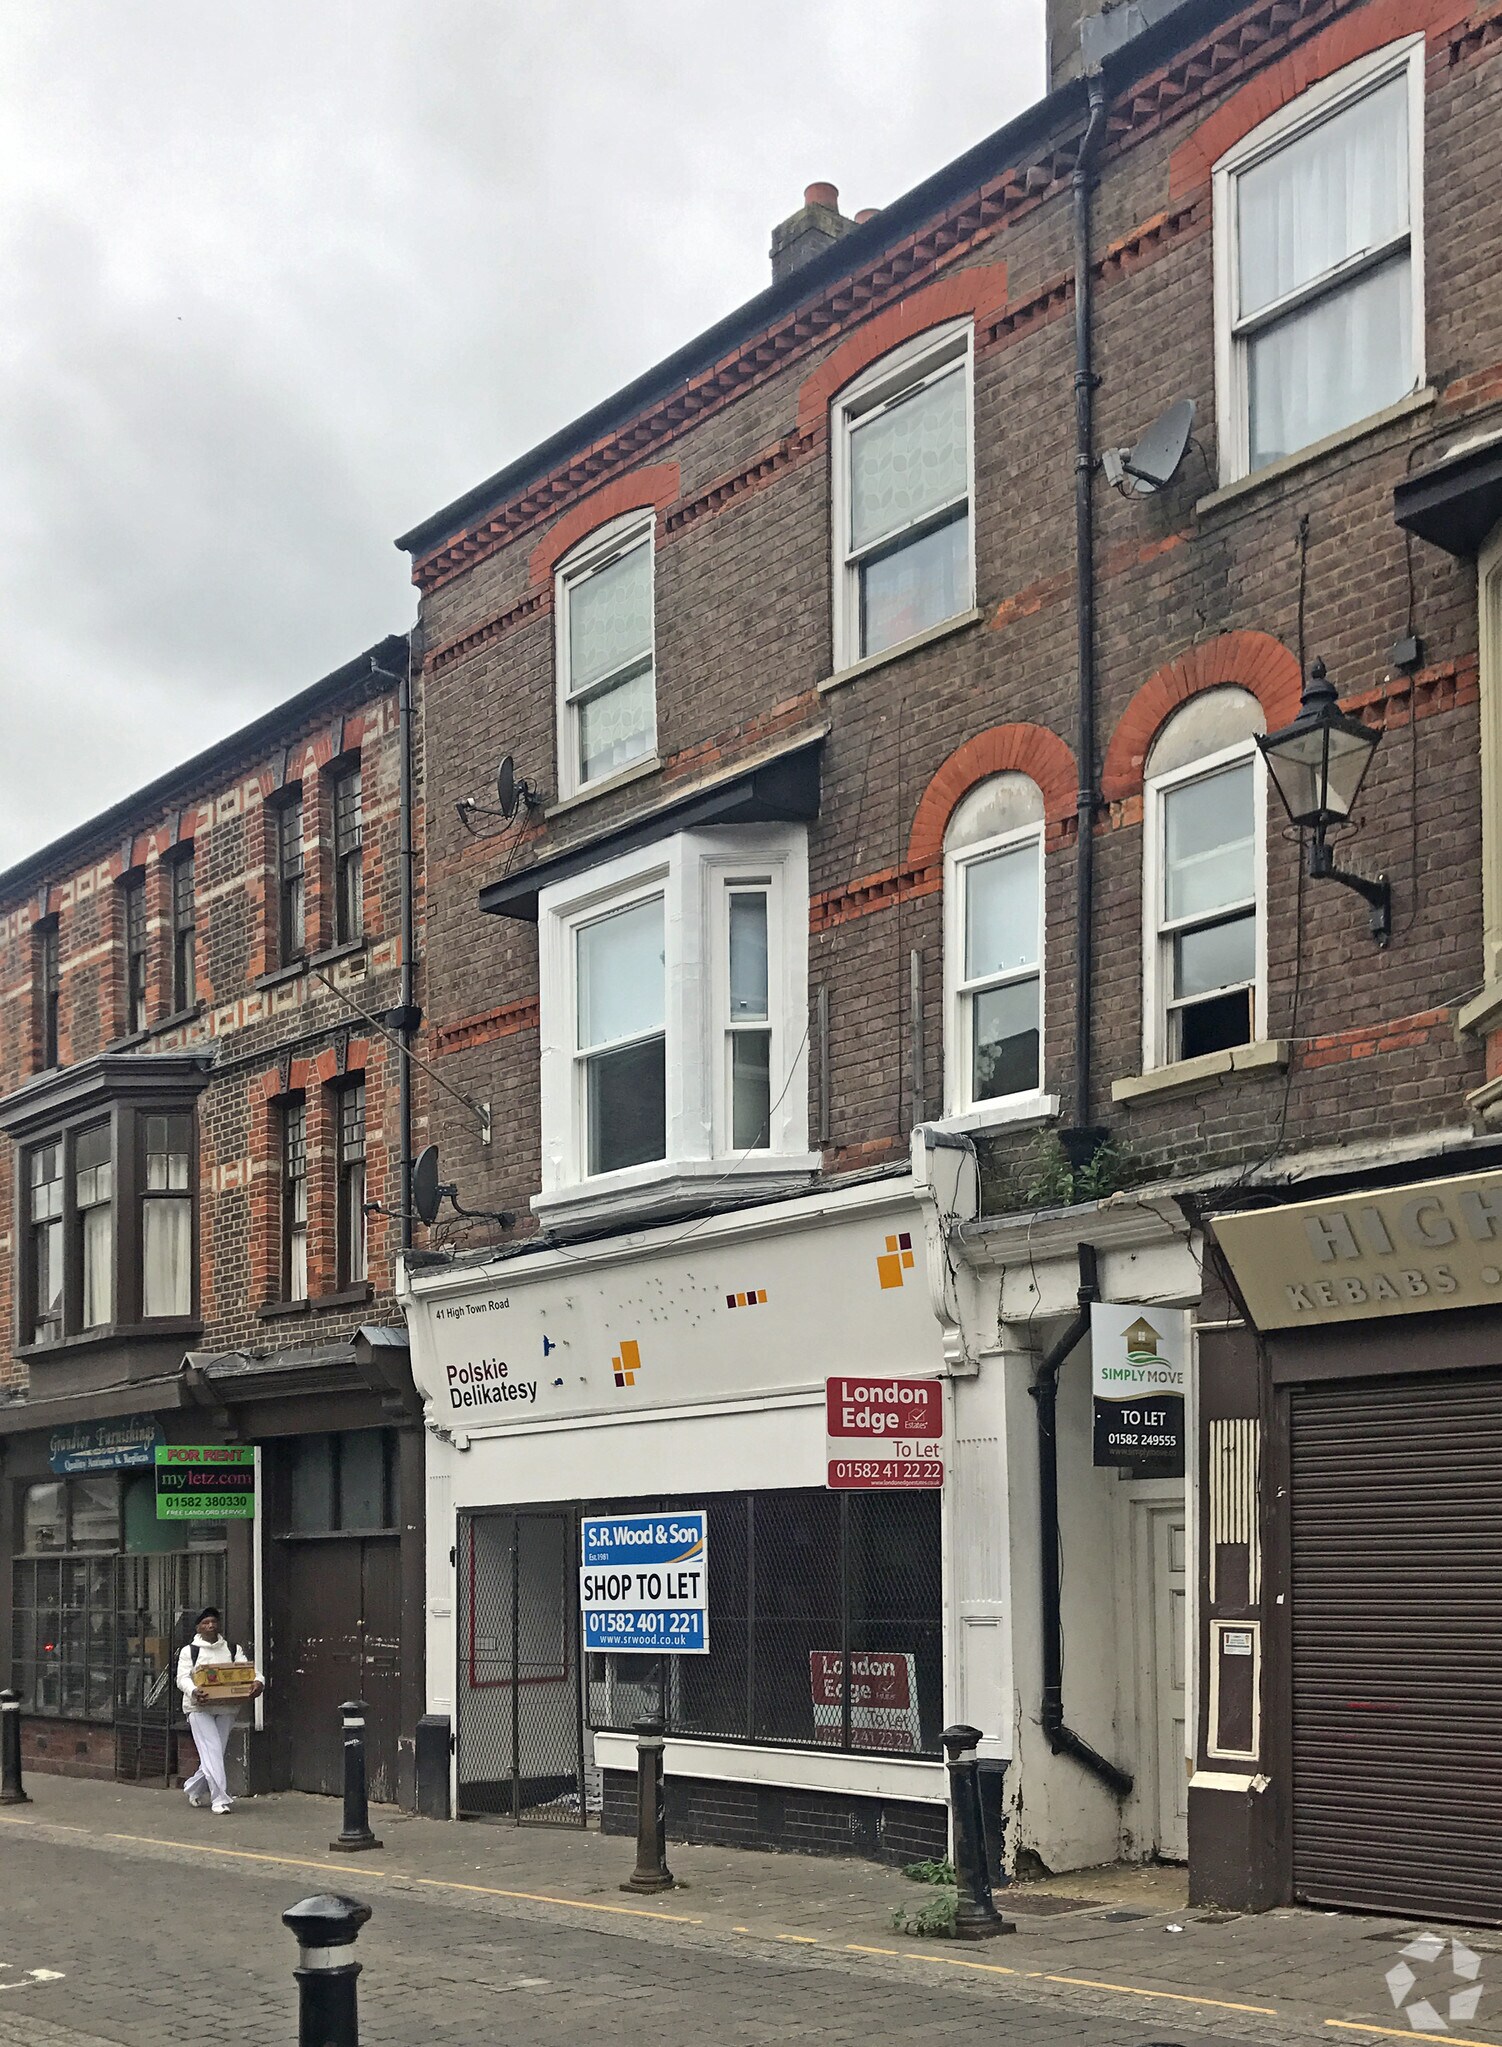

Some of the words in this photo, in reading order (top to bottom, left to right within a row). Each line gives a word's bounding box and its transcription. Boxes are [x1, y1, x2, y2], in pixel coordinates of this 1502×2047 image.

[1286, 1264, 1458, 1310] KEBABS
[436, 1309, 445, 1319] 41
[447, 1306, 464, 1319] High
[466, 1304, 487, 1314] Town
[488, 1298, 510, 1310] Road
[446, 1358, 508, 1386] Polskie
[1101, 1368, 1145, 1382] SIMPLY
[1147, 1371, 1184, 1384] MOVE
[449, 1381, 537, 1408] Delikatesy
[841, 1382, 928, 1404] London
[842, 1407, 899, 1434] Edge
[1121, 1410, 1140, 1425] TO
[1144, 1411, 1166, 1426] LET
[95, 1417, 155, 1451] Furnishings
[1108, 1433, 1138, 1445] 01582
[1140, 1434, 1177, 1446] 249555
[167, 1450, 201, 1461] FOR
[203, 1450, 245, 1461] RENT
[893, 1441, 911, 1457] To
[916, 1441, 940, 1458] Let
[836, 1463, 880, 1478] 01582
[882, 1463, 899, 1478] 41
[903, 1463, 920, 1478] 22
[923, 1463, 941, 1478] 22
[166, 1496, 201, 1507] 01582
[205, 1496, 247, 1507] 380330
[655, 1524, 668, 1544] &
[669, 1523, 699, 1543] Son
[584, 1574, 632, 1601] SHOP
[636, 1573, 662, 1600] TO
[667, 1572, 700, 1599] LET
[589, 1613, 635, 1632] 01582
[636, 1613, 665, 1632] 401
[669, 1613, 699, 1632] 221
[600, 1634, 686, 1645] www.srwood.co.uk
